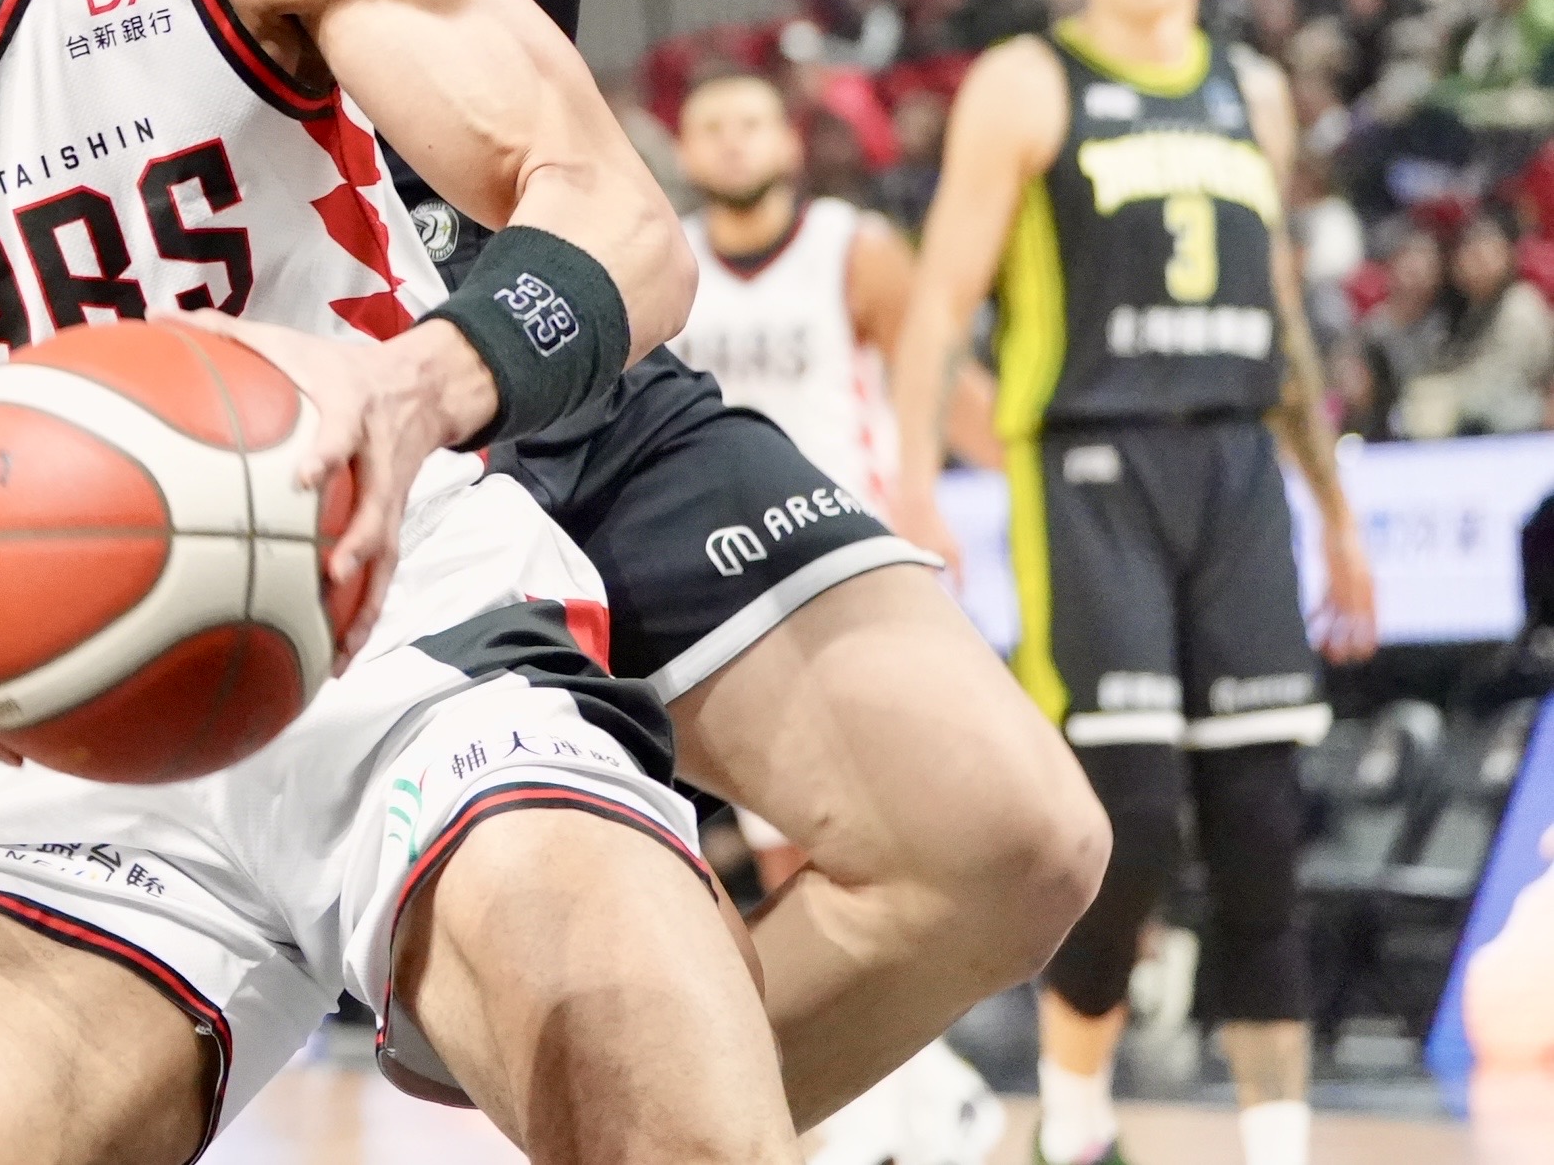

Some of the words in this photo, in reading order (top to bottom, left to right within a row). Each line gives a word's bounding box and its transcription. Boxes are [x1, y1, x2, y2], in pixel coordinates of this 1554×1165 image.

[65, 8, 172, 59] 台新銀行
[493, 272, 580, 357] 33
